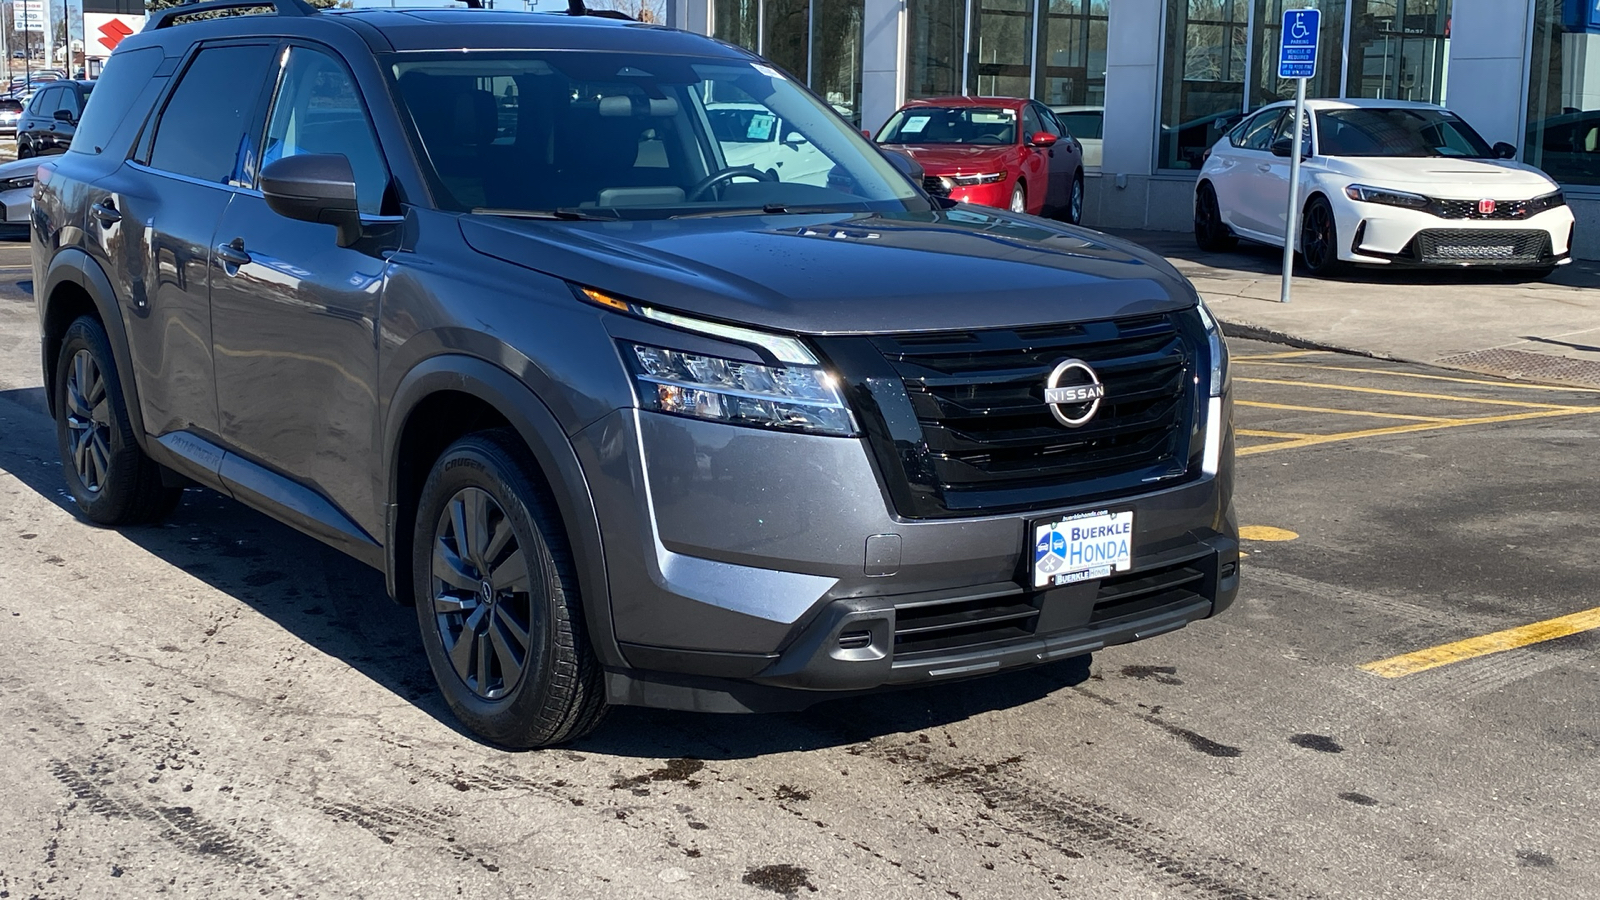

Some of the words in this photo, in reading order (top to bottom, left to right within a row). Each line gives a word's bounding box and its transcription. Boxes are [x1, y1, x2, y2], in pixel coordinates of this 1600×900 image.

[1047, 385, 1104, 402] NISSAN
[1071, 522, 1130, 542] BUERKLE
[1070, 539, 1129, 566] HONDA
[1056, 570, 1089, 585] BUERKLE
[1090, 566, 1110, 578] HONDA
